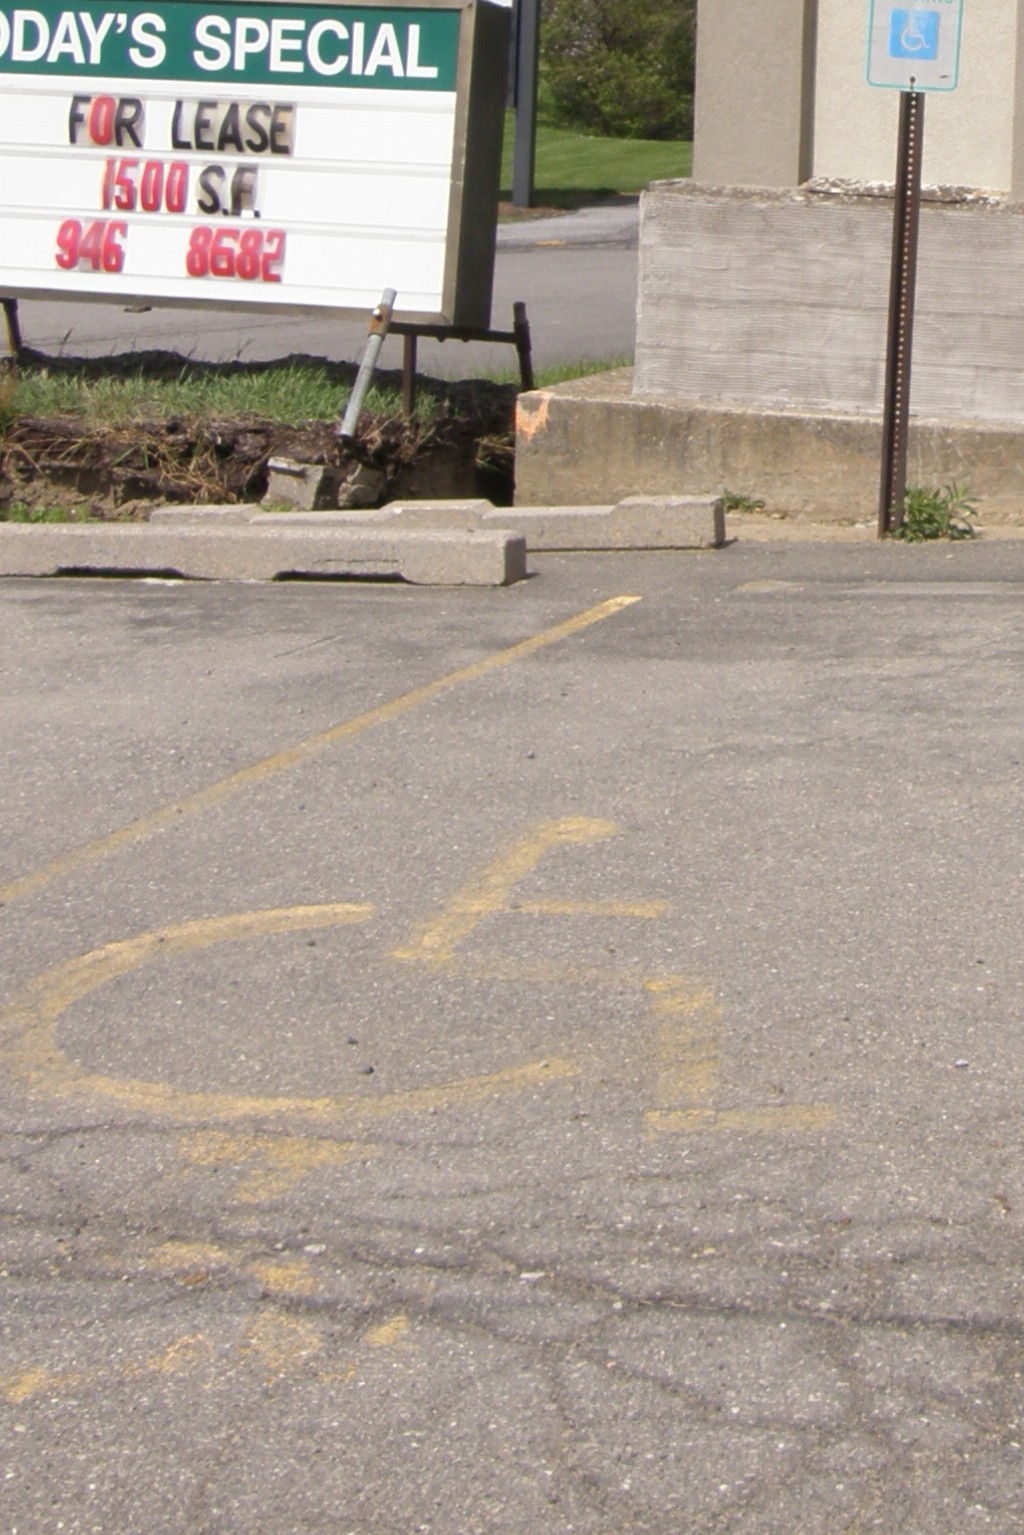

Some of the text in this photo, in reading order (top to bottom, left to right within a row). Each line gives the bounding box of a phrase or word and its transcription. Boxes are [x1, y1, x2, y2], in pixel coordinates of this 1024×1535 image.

[193, 15, 439, 78] SPECIAL
[68, 95, 294, 155] FOR LEASE
[102, 159, 190, 213] 1500
[55, 219, 287, 283] 946 8682
